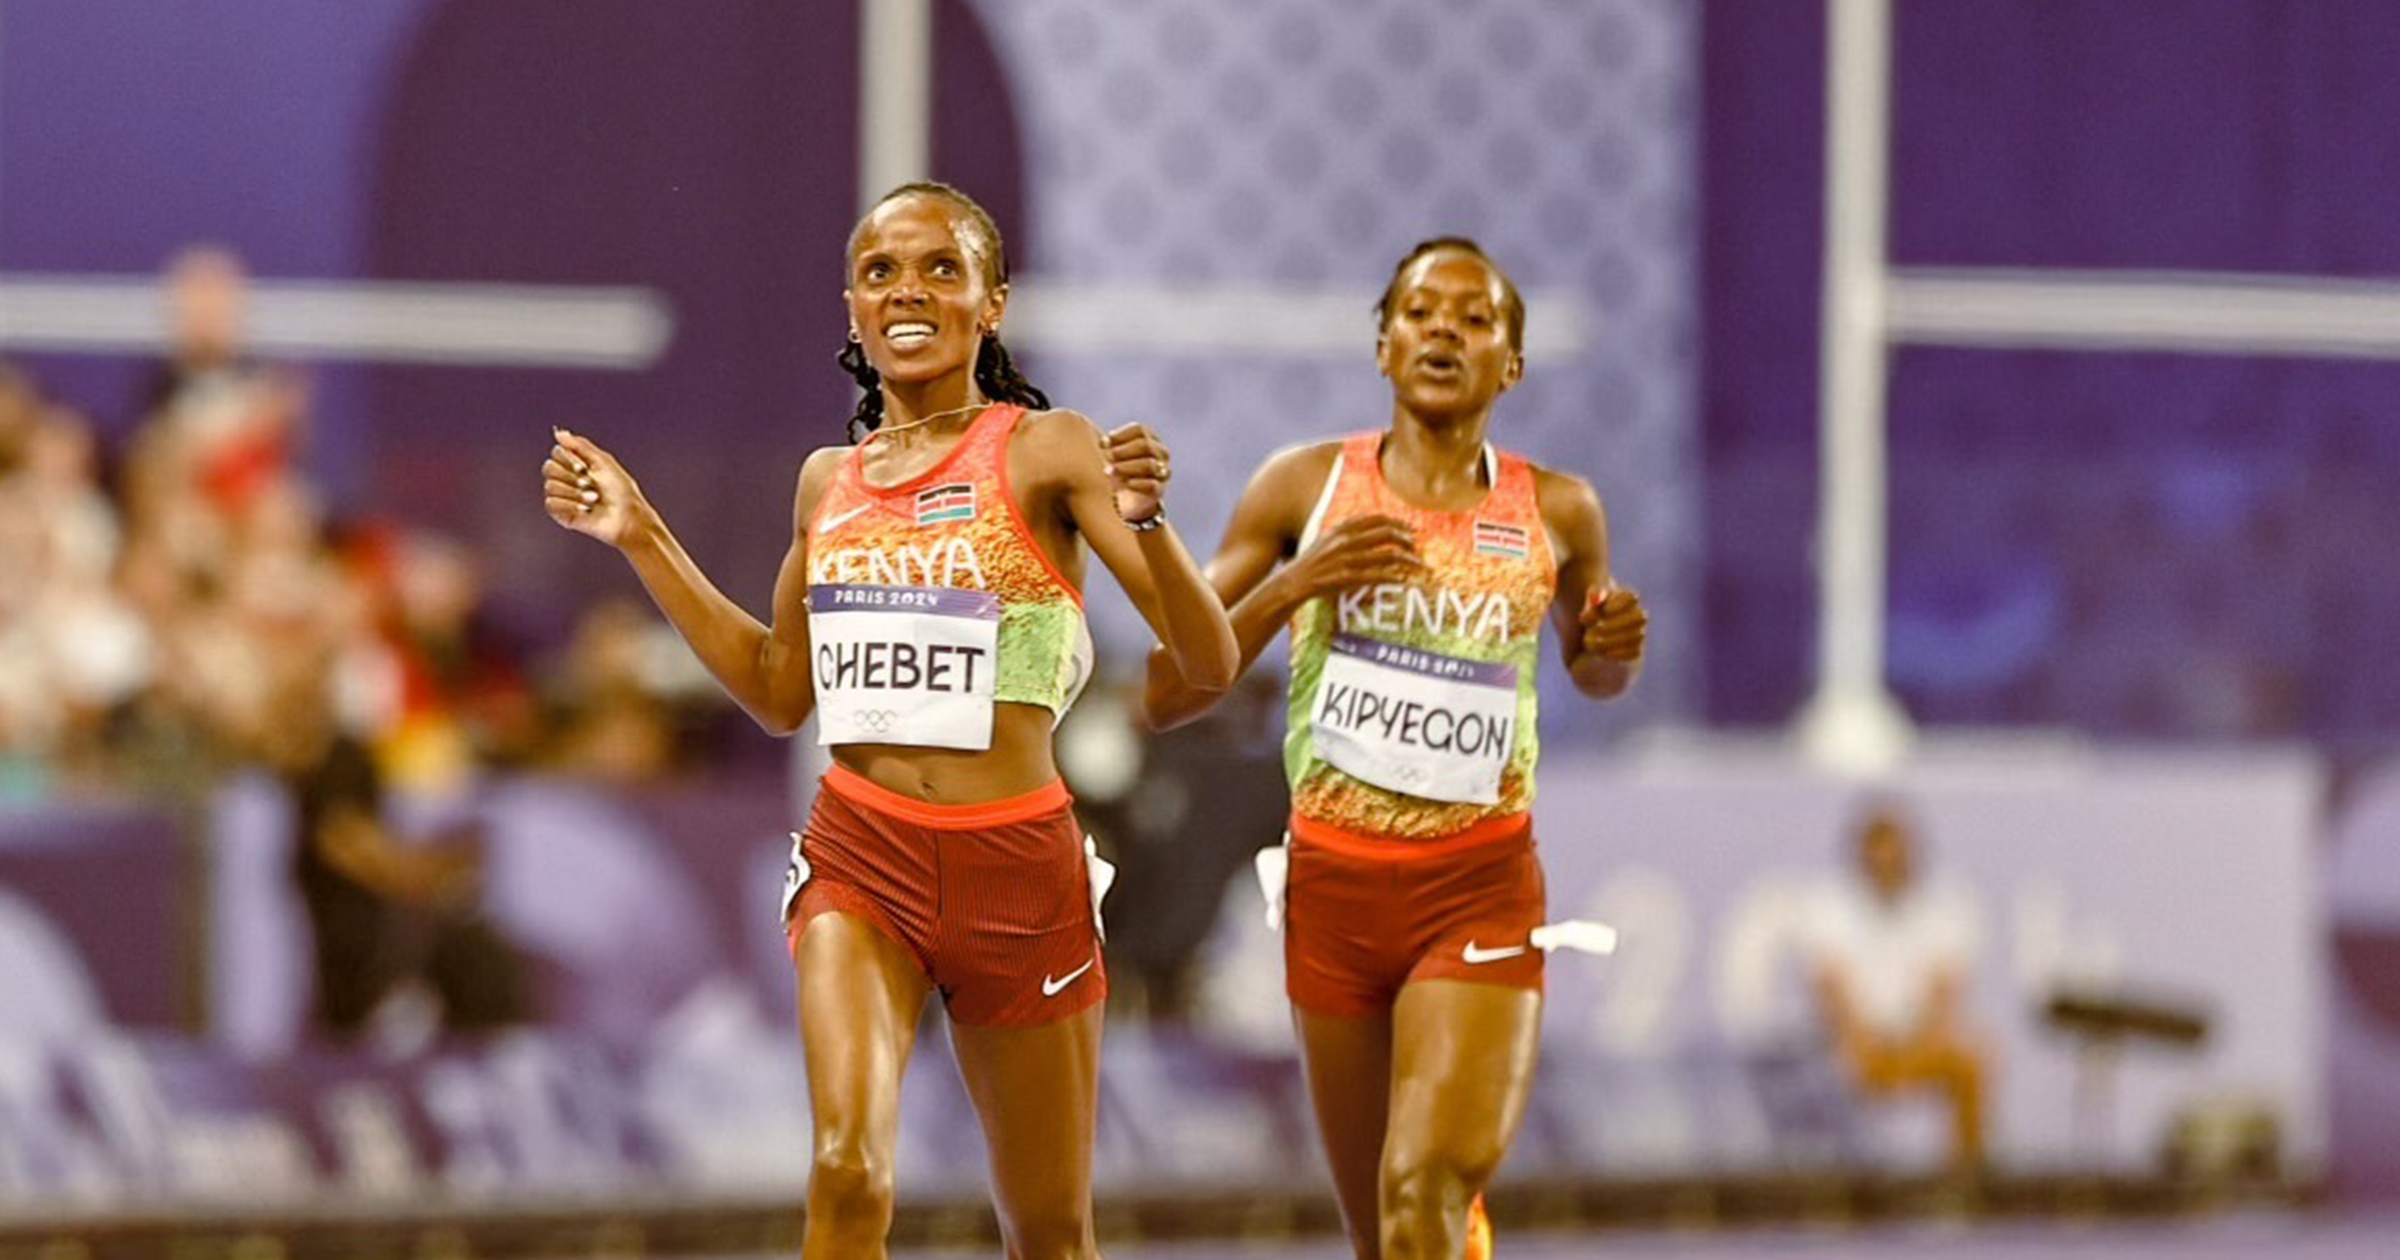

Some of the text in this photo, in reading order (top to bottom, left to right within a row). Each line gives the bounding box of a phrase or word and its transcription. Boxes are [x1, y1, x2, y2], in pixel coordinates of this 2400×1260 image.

[813, 537, 987, 590] KENYA
[834, 589, 939, 606] PARIS 2024
[1338, 584, 1511, 644] KENYA
[817, 642, 986, 693] CHEBET
[1376, 643, 1430, 672] PARIS
[1318, 682, 1509, 761] KIPYEGON
